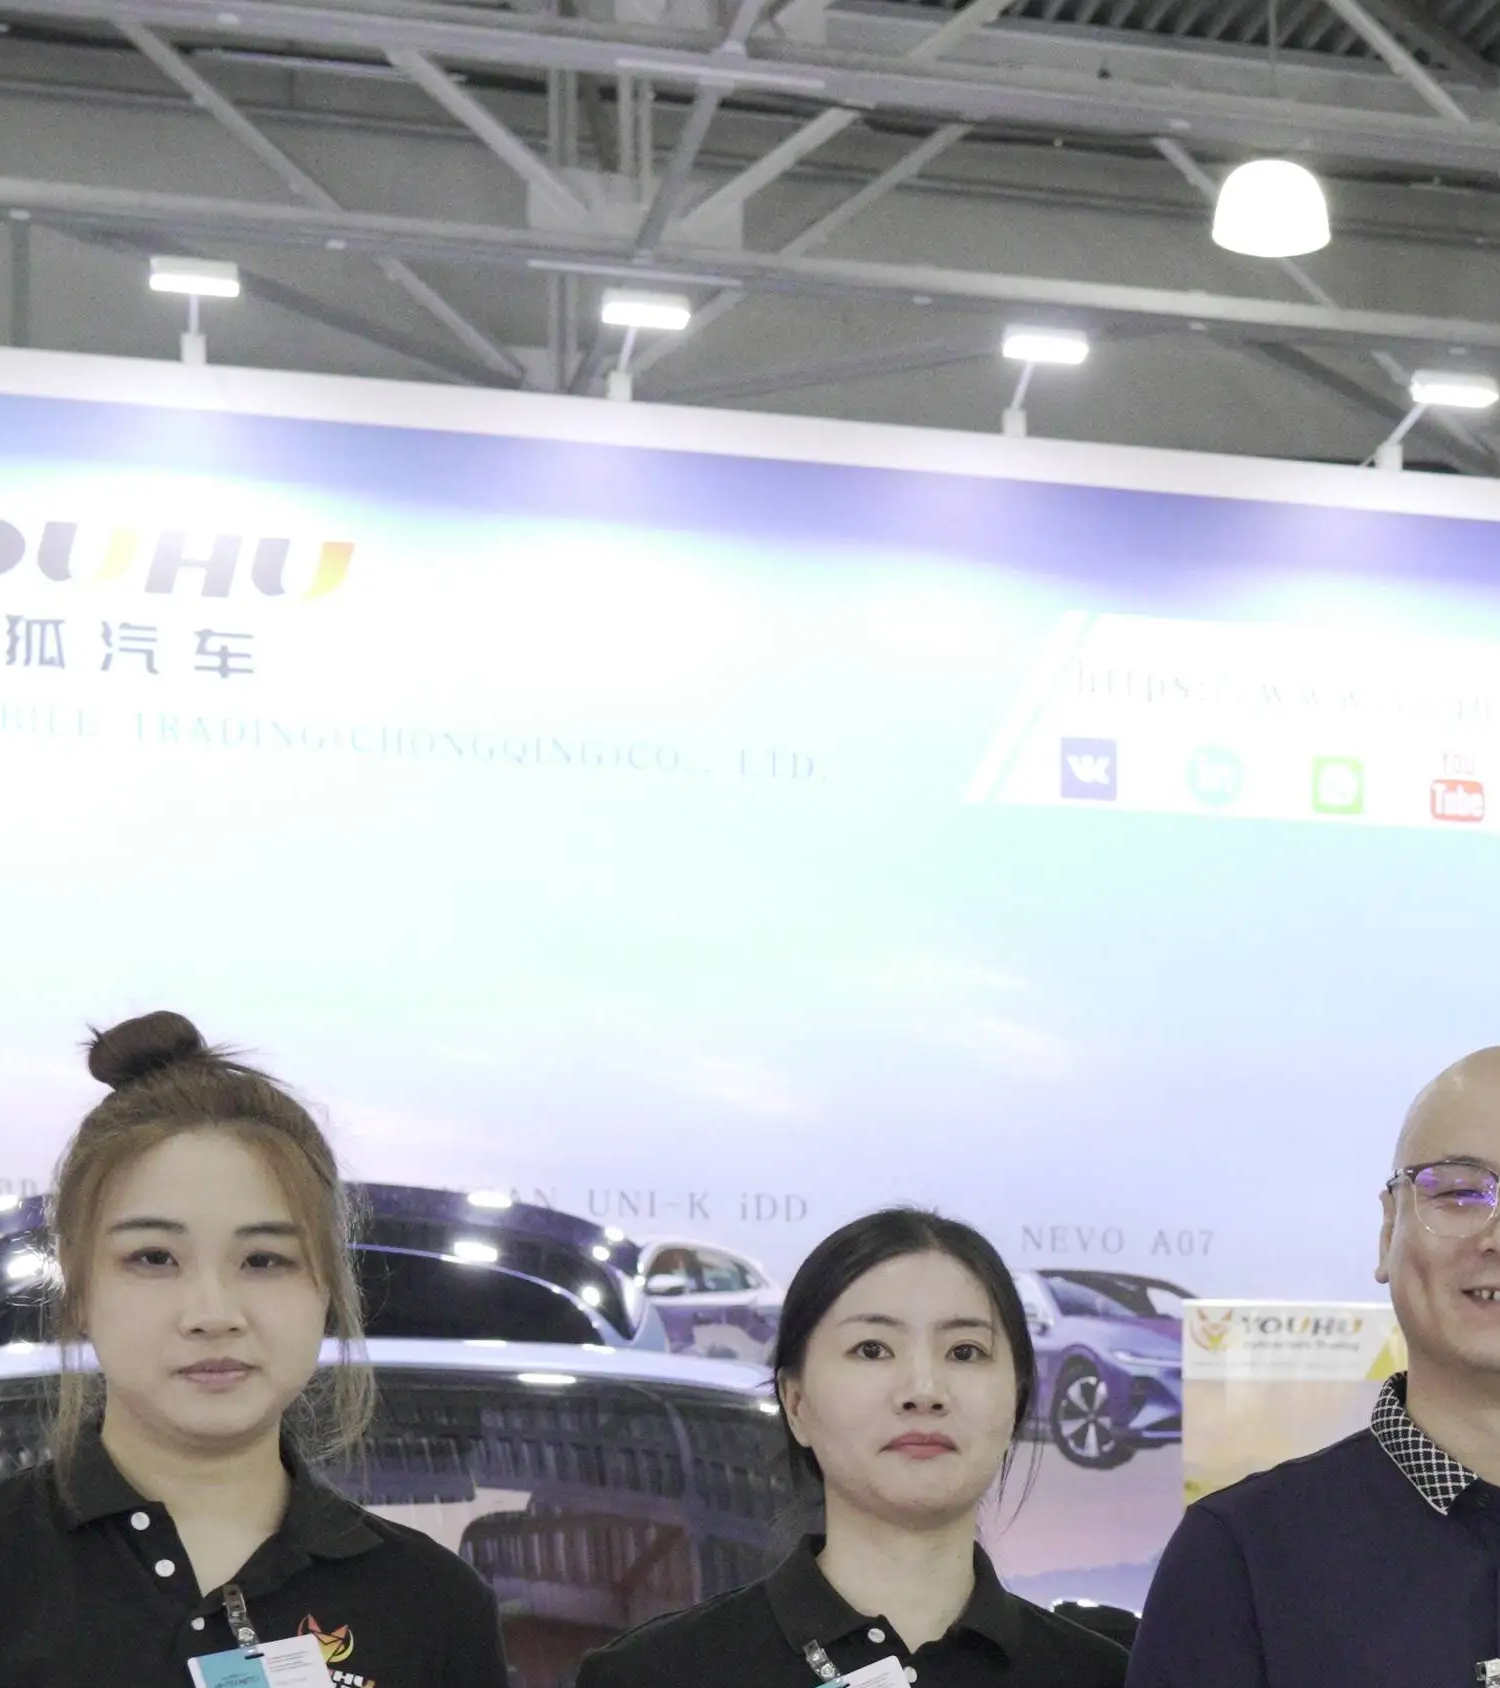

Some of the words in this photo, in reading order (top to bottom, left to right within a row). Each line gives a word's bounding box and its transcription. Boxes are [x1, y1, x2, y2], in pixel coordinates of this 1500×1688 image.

[587, 1188, 712, 1222] UNI-K
[739, 1193, 809, 1223] iDD
[1020, 1224, 1125, 1255] NEVO
[1150, 1229, 1216, 1257] A07
